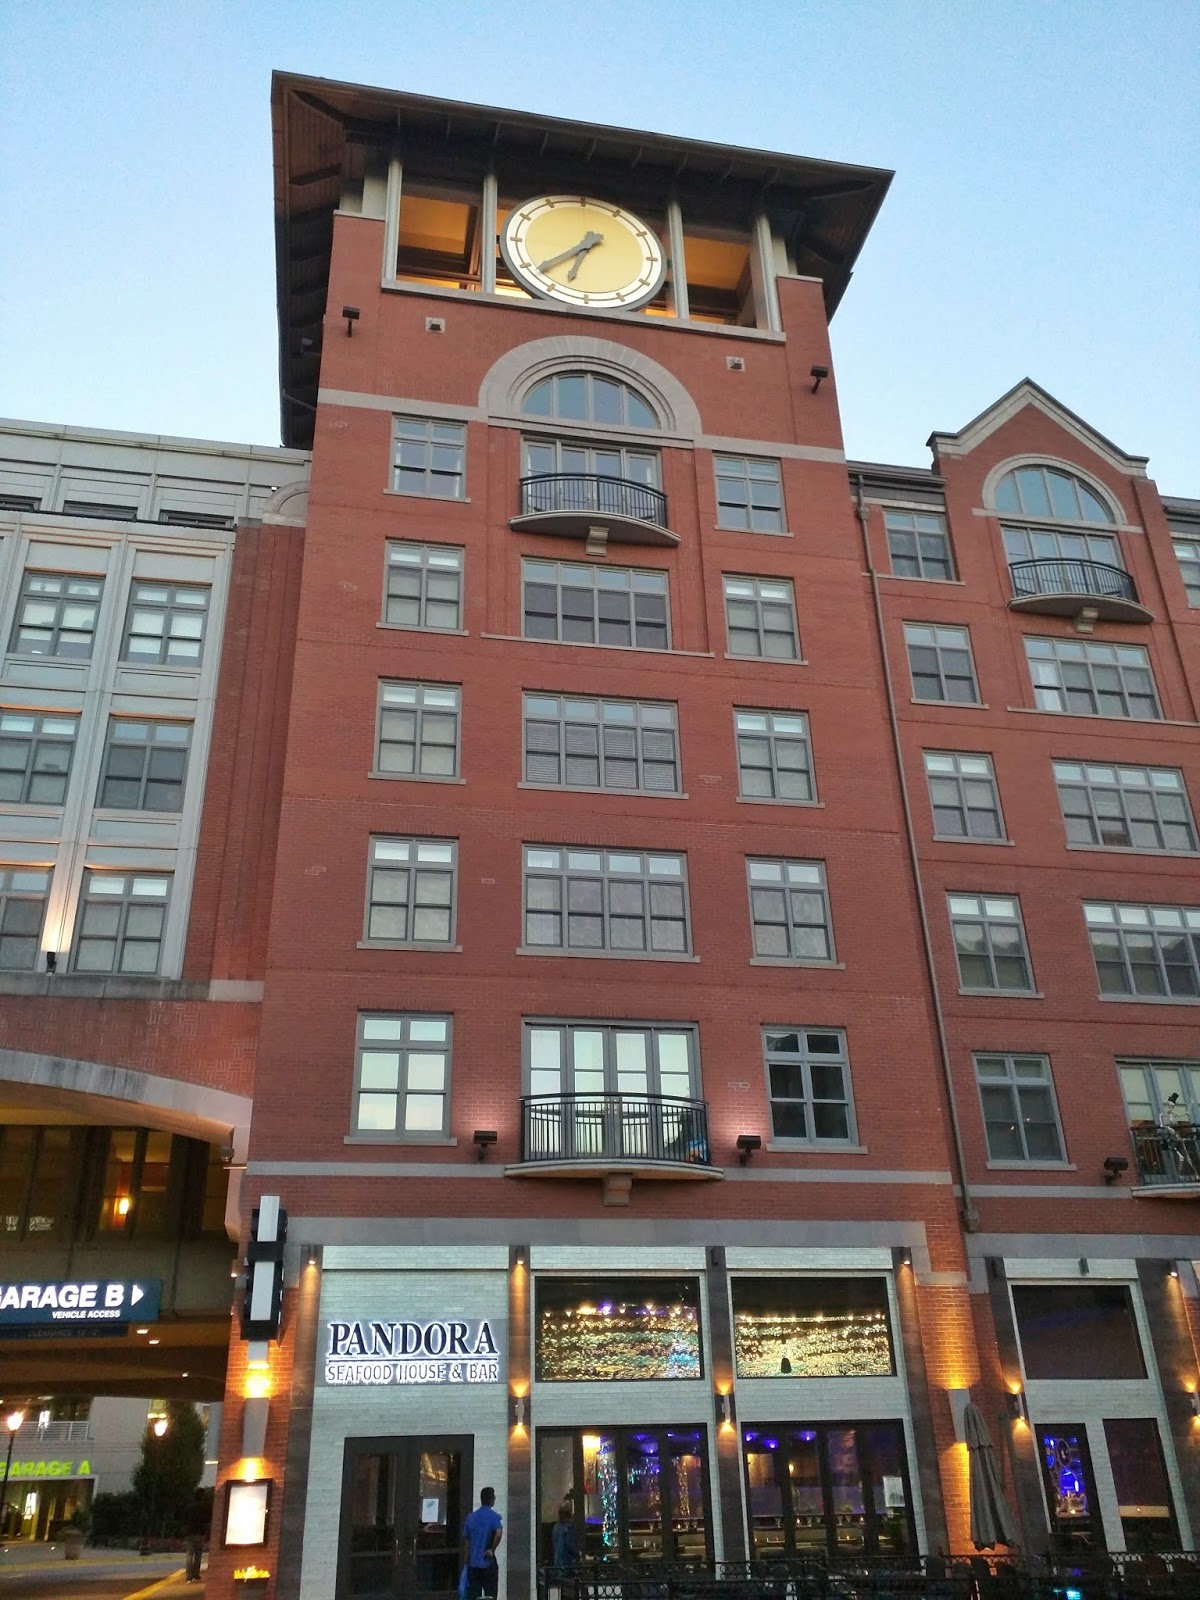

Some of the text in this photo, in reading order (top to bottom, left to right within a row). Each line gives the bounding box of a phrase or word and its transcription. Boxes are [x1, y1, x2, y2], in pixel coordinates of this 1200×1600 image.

[0, 1284, 124, 1309] ARAGE B
[52, 1309, 121, 1319] VEHICLE ACCESS
[328, 1322, 498, 1356] PANDORA
[327, 1363, 498, 1382] SEAFOOD HOUSE & BAR
[78, 1460, 91, 1475] A
